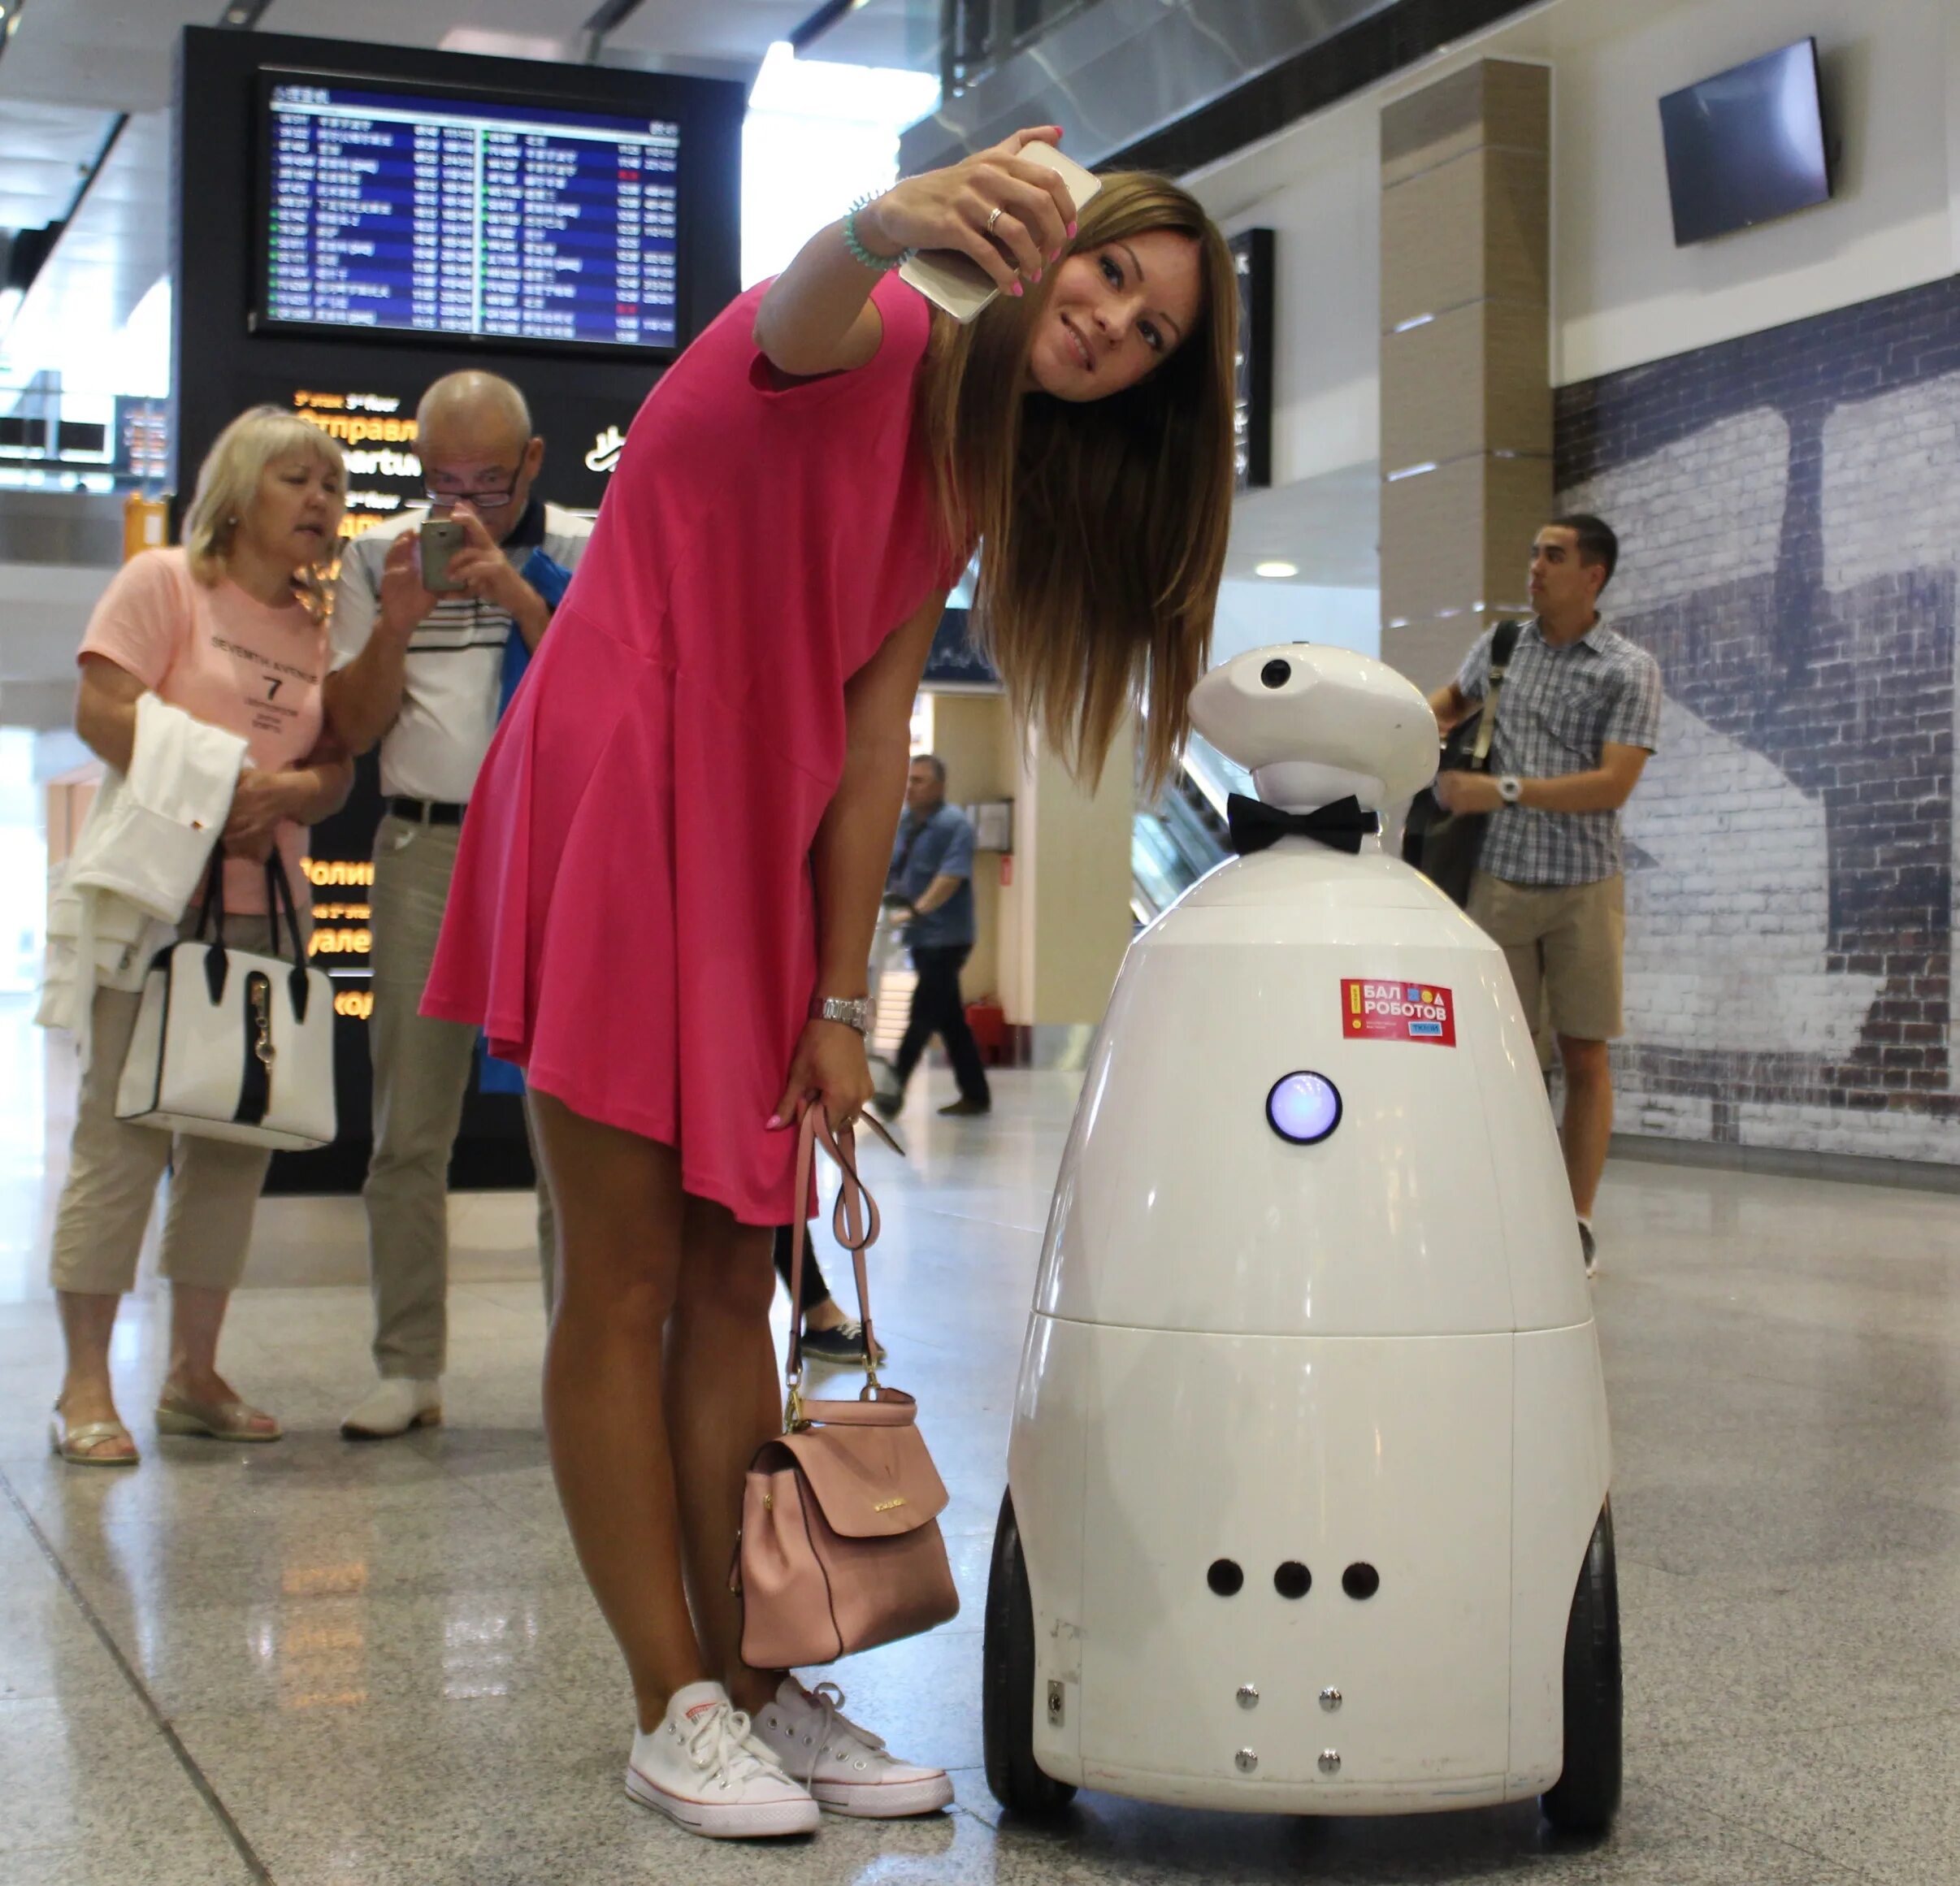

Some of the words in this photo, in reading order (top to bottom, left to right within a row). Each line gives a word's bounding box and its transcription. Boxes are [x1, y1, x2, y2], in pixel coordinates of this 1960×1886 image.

[262, 675, 282, 700] 7
[1364, 985, 1401, 1000] БАЛ
[1364, 1000, 1446, 1021] РОБОТОВ
